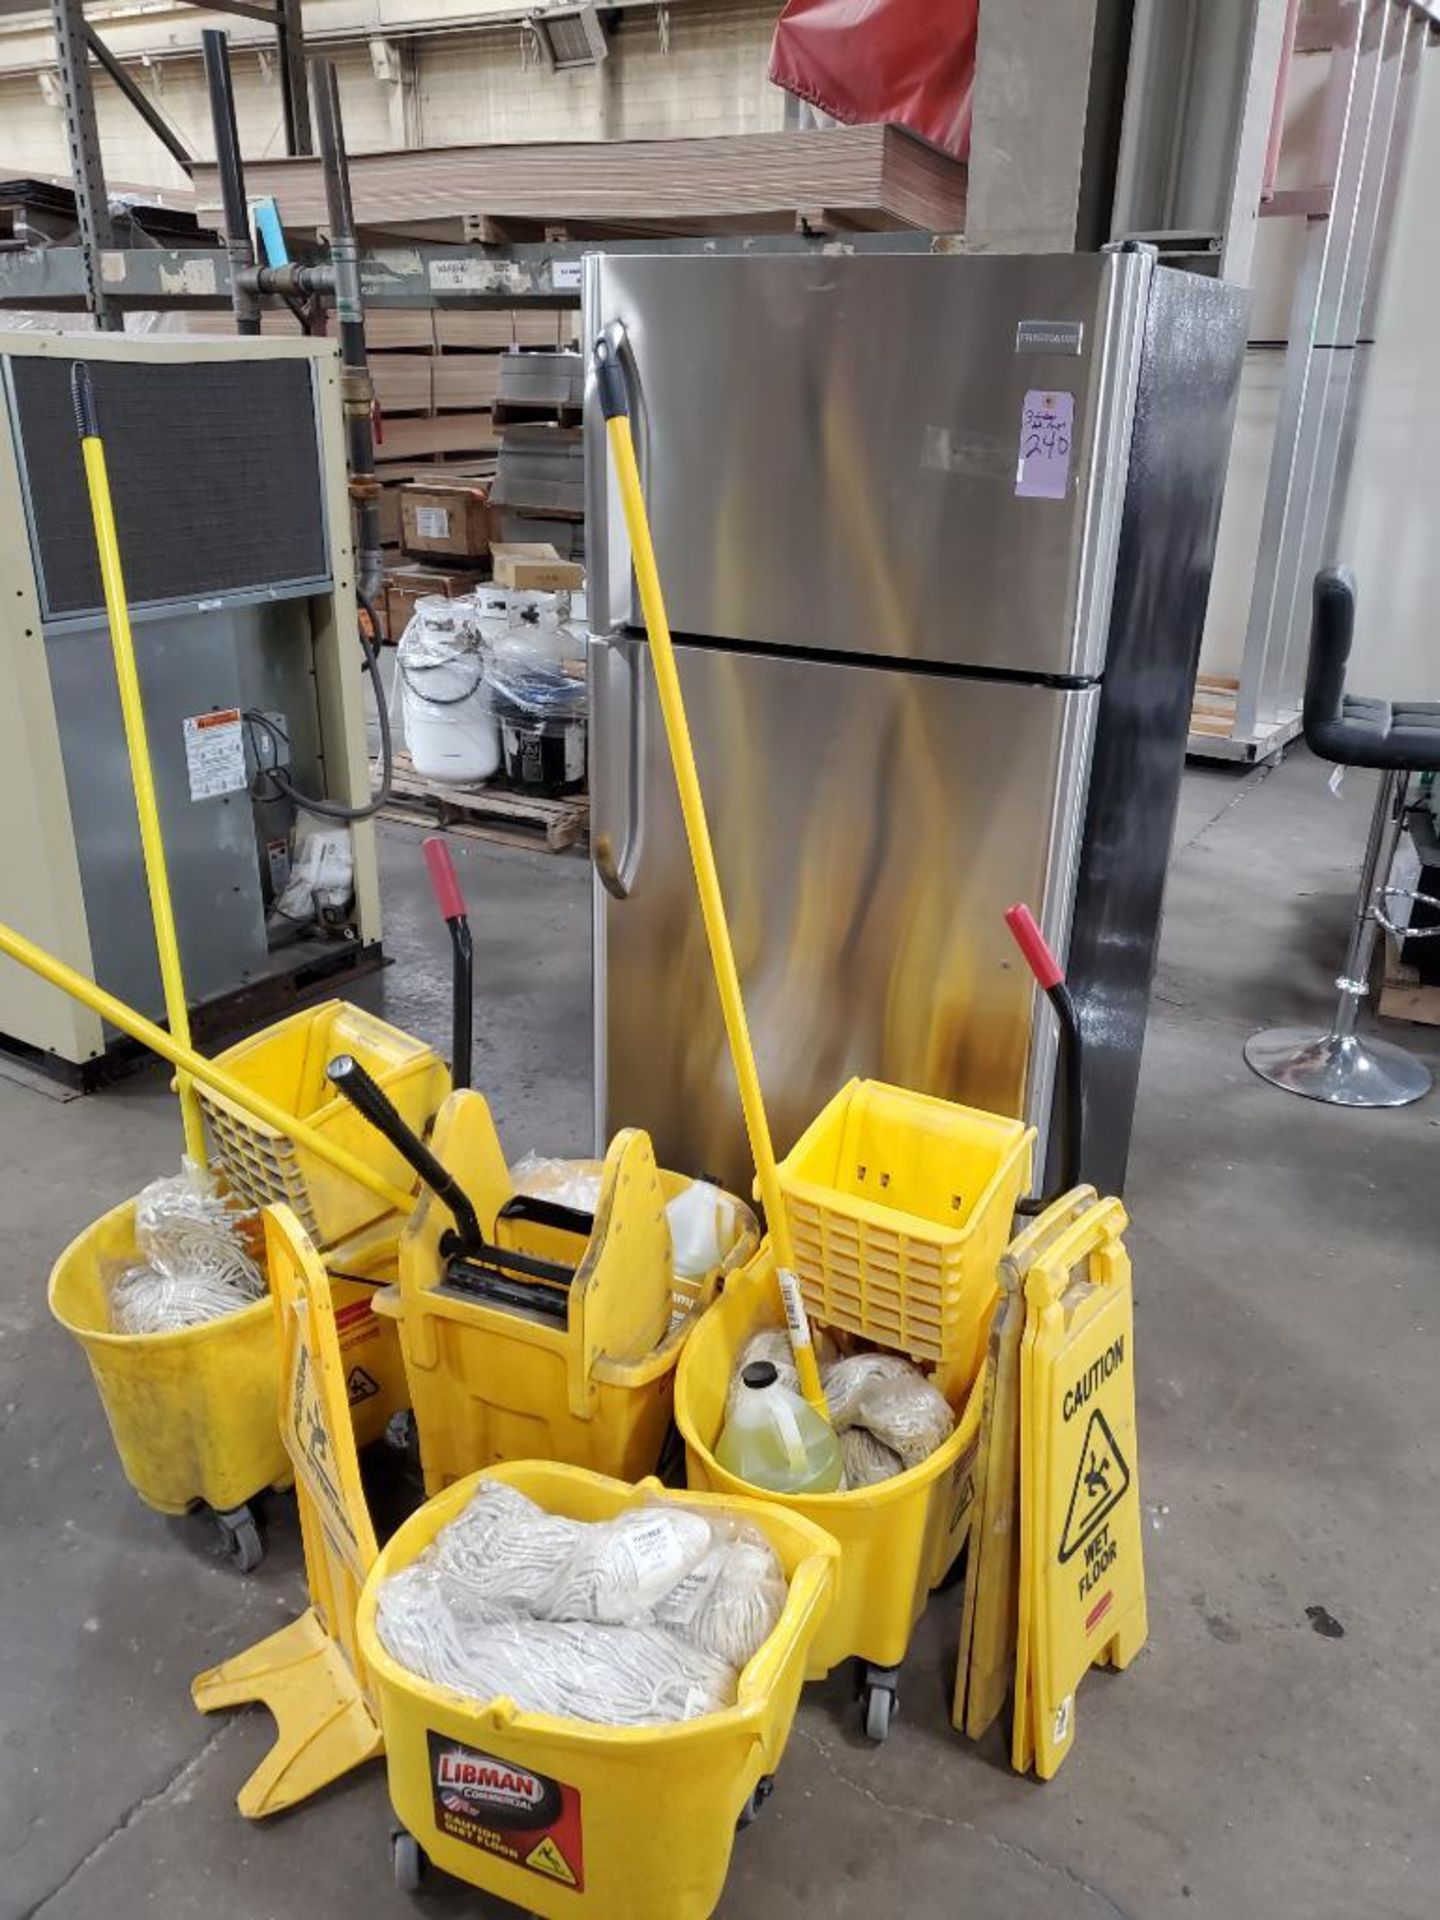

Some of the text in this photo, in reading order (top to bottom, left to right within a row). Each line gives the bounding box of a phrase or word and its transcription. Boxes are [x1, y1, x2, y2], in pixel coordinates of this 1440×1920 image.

[1025, 431, 1069, 459] 240
[1062, 1334, 1124, 1423] CAUTION
[1084, 1522, 1109, 1568] WET
[1078, 1540, 1117, 1602] FLOOR
[441, 1756, 534, 1797] LIBMAN
[443, 1811, 502, 1843] CAUTION
[444, 1822, 519, 1859] WET FLOOR
